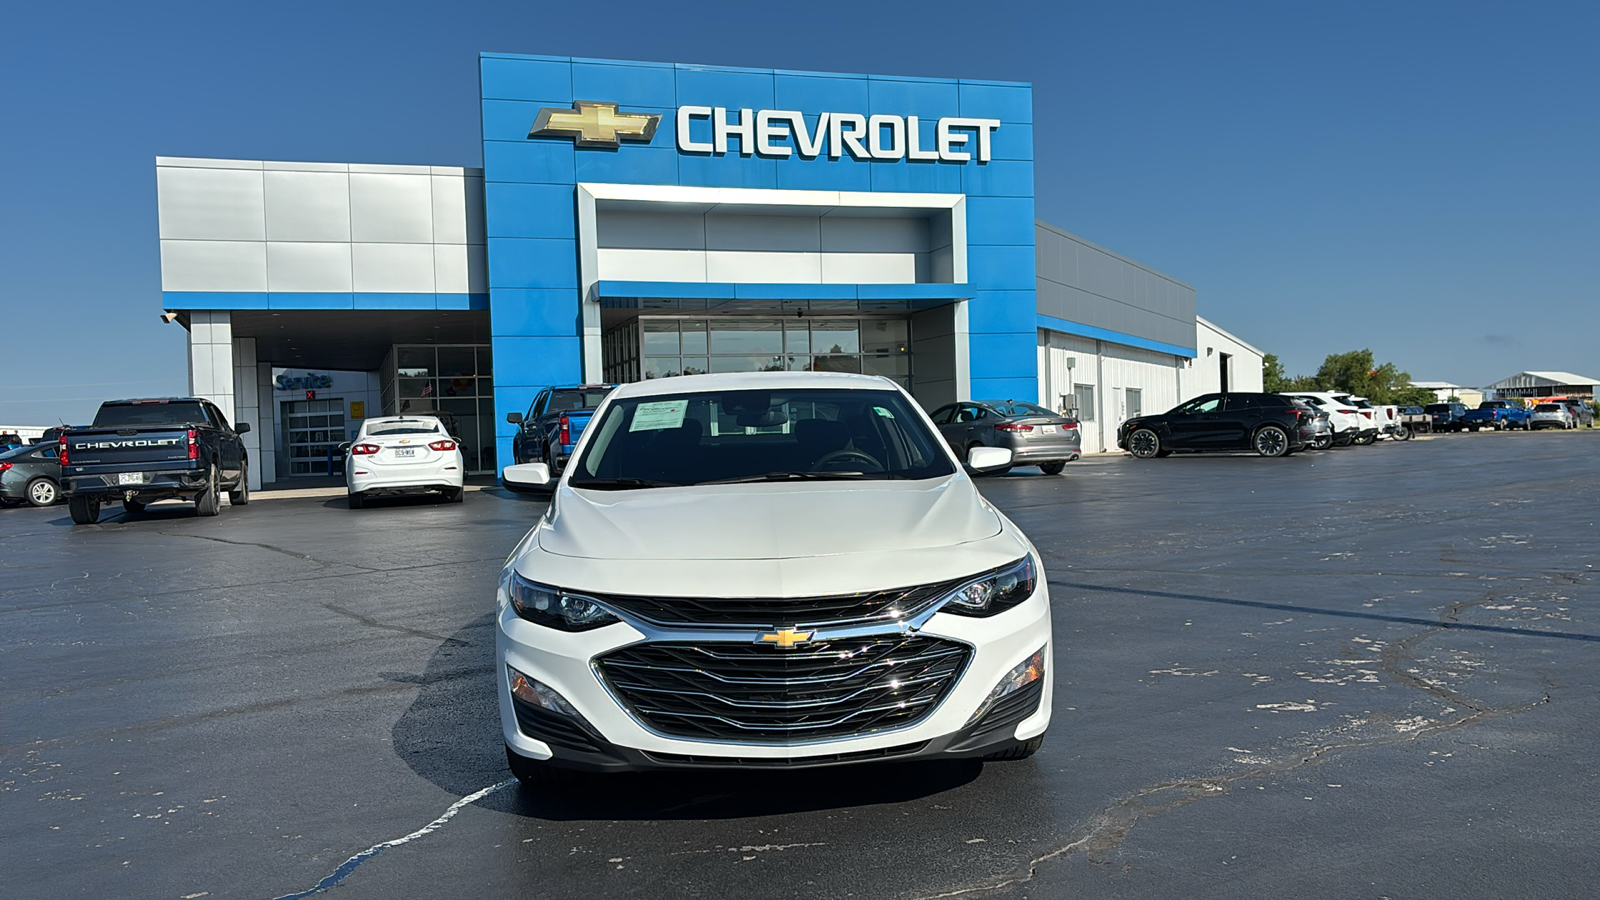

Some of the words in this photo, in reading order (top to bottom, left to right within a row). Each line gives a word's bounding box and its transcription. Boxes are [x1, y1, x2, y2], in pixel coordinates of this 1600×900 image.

[677, 105, 1000, 162] CHEVROLET
[276, 373, 332, 390] Service
[75, 439, 180, 449] CHEVROLET
